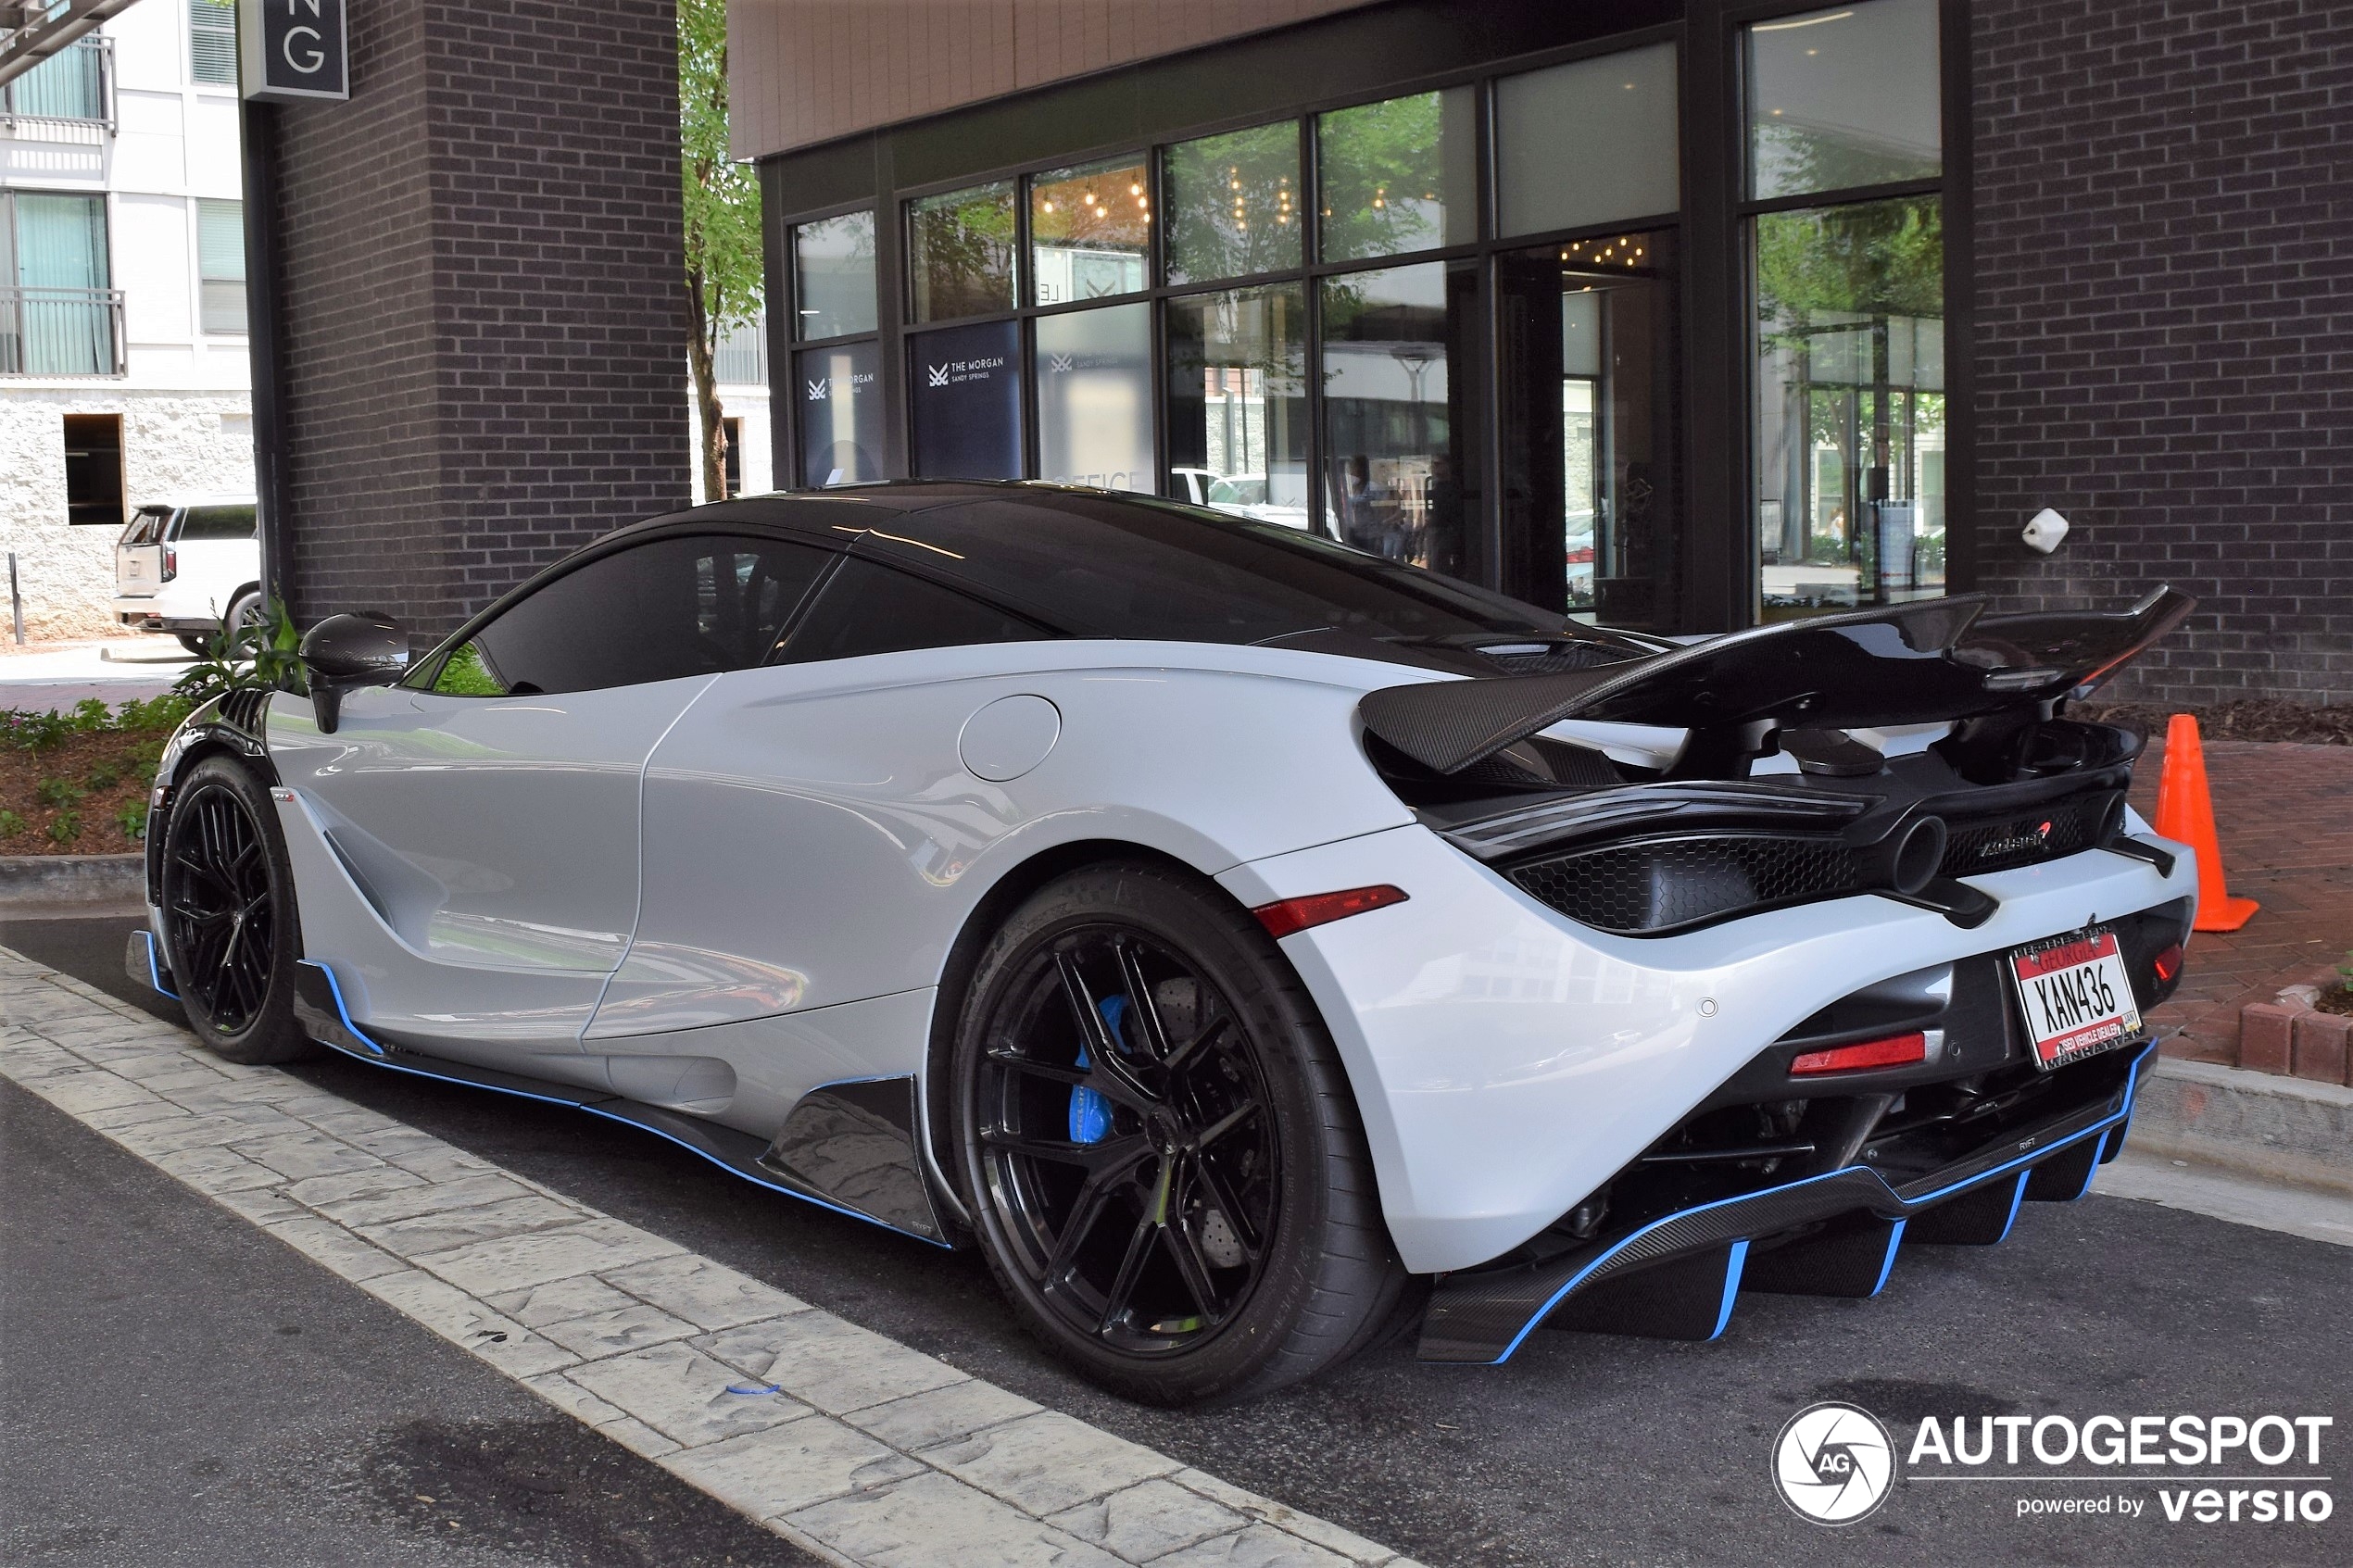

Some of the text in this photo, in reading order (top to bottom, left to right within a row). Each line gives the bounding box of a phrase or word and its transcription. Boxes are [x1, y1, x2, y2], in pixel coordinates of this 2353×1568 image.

[951, 357, 1003, 372] THE MORGAN
[969, 372, 989, 381] SPRINGS
[2038, 944, 2097, 972] GEORGIA
[2034, 963, 2115, 1034] XAN436
[2074, 1030, 2098, 1047] VEHICLE
[2096, 1022, 2118, 1039] DEALER
[2044, 1029, 2143, 1070] MANHATTAN
